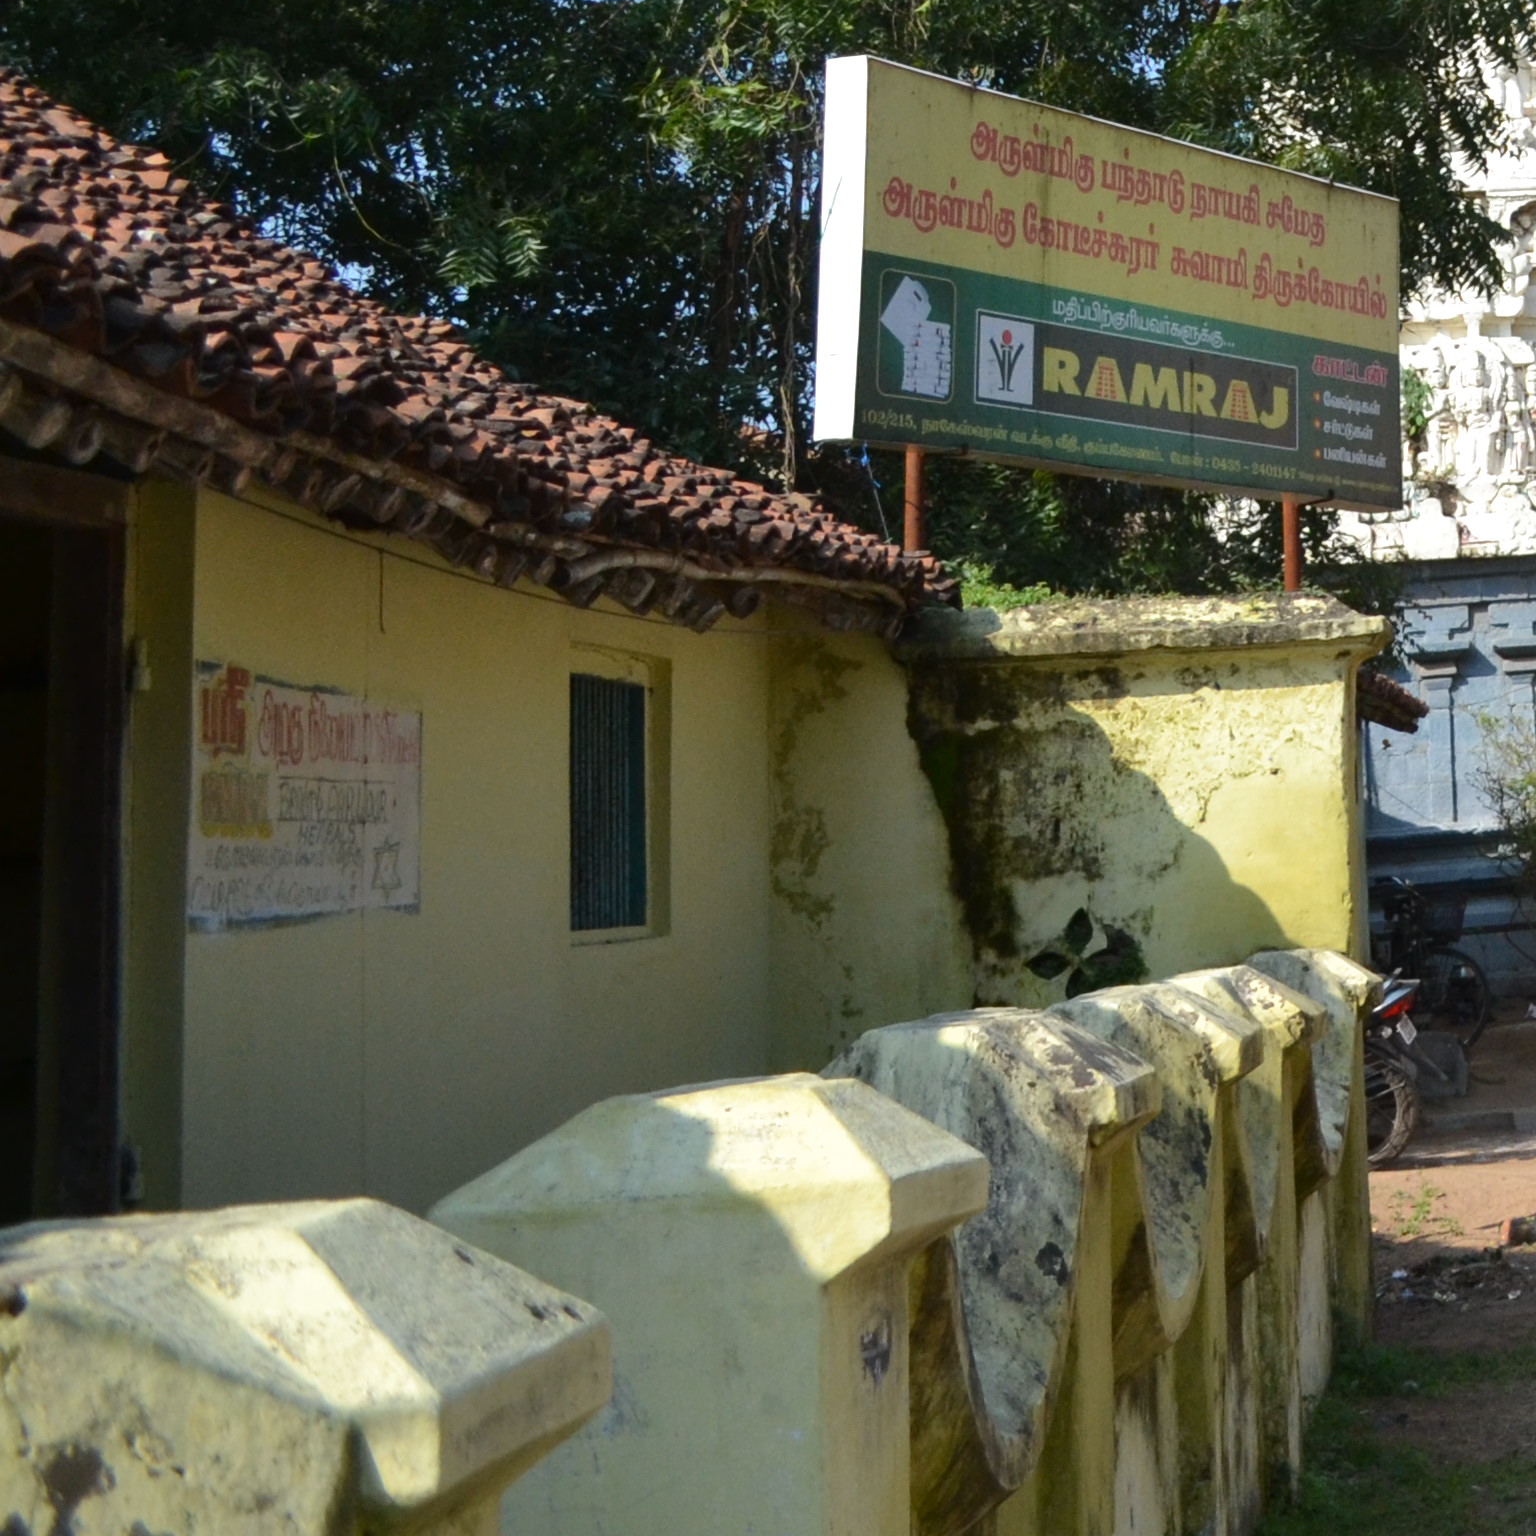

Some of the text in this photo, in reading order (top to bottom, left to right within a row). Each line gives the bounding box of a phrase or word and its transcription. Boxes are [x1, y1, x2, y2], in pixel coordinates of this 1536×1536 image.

[971, 121, 1325, 248] அருள்மிகு பந்தாடு நாயகி சமேத
[883, 176, 1016, 248] அருள்மிகு
[1171, 248, 1248, 290] சுவாமி
[1252, 252, 1387, 320] திருக்கோயில்
[1043, 346, 1289, 430] RAMRAJ
[1312, 355, 1389, 388] காட்டன்
[1323, 447, 1387, 468] பனியன்கள்
